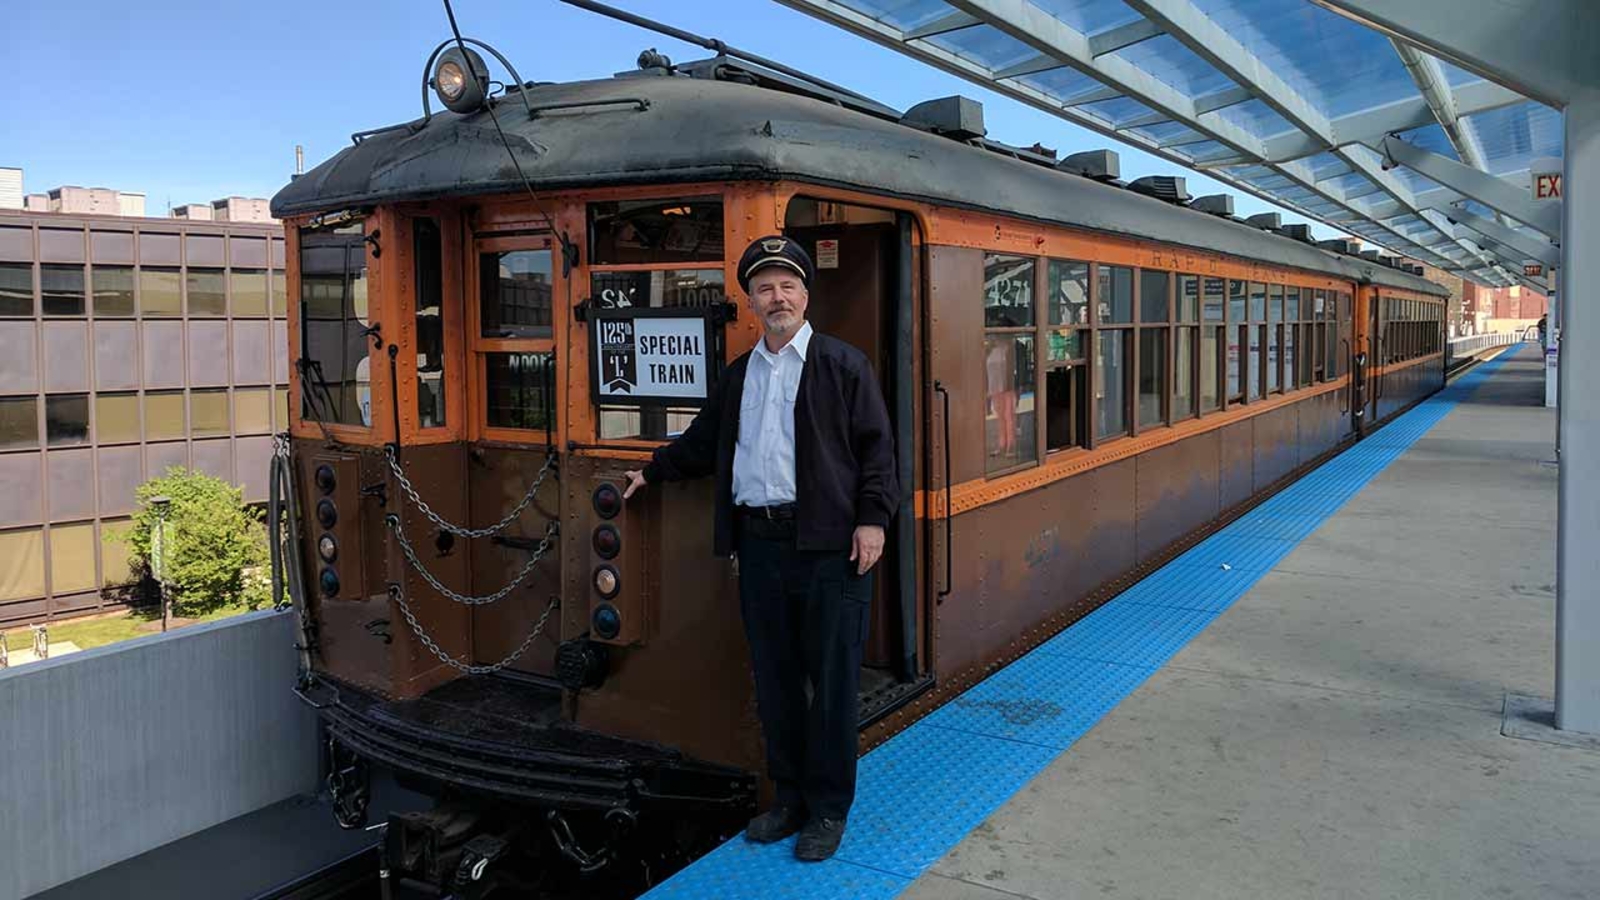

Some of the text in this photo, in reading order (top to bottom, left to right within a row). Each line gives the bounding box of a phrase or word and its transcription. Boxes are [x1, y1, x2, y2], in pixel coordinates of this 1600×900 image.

[1537, 174, 1562, 198] EX
[988, 278, 1030, 308] 4271
[640, 335, 702, 356] SPECIAL
[649, 363, 695, 384] TRAIN
